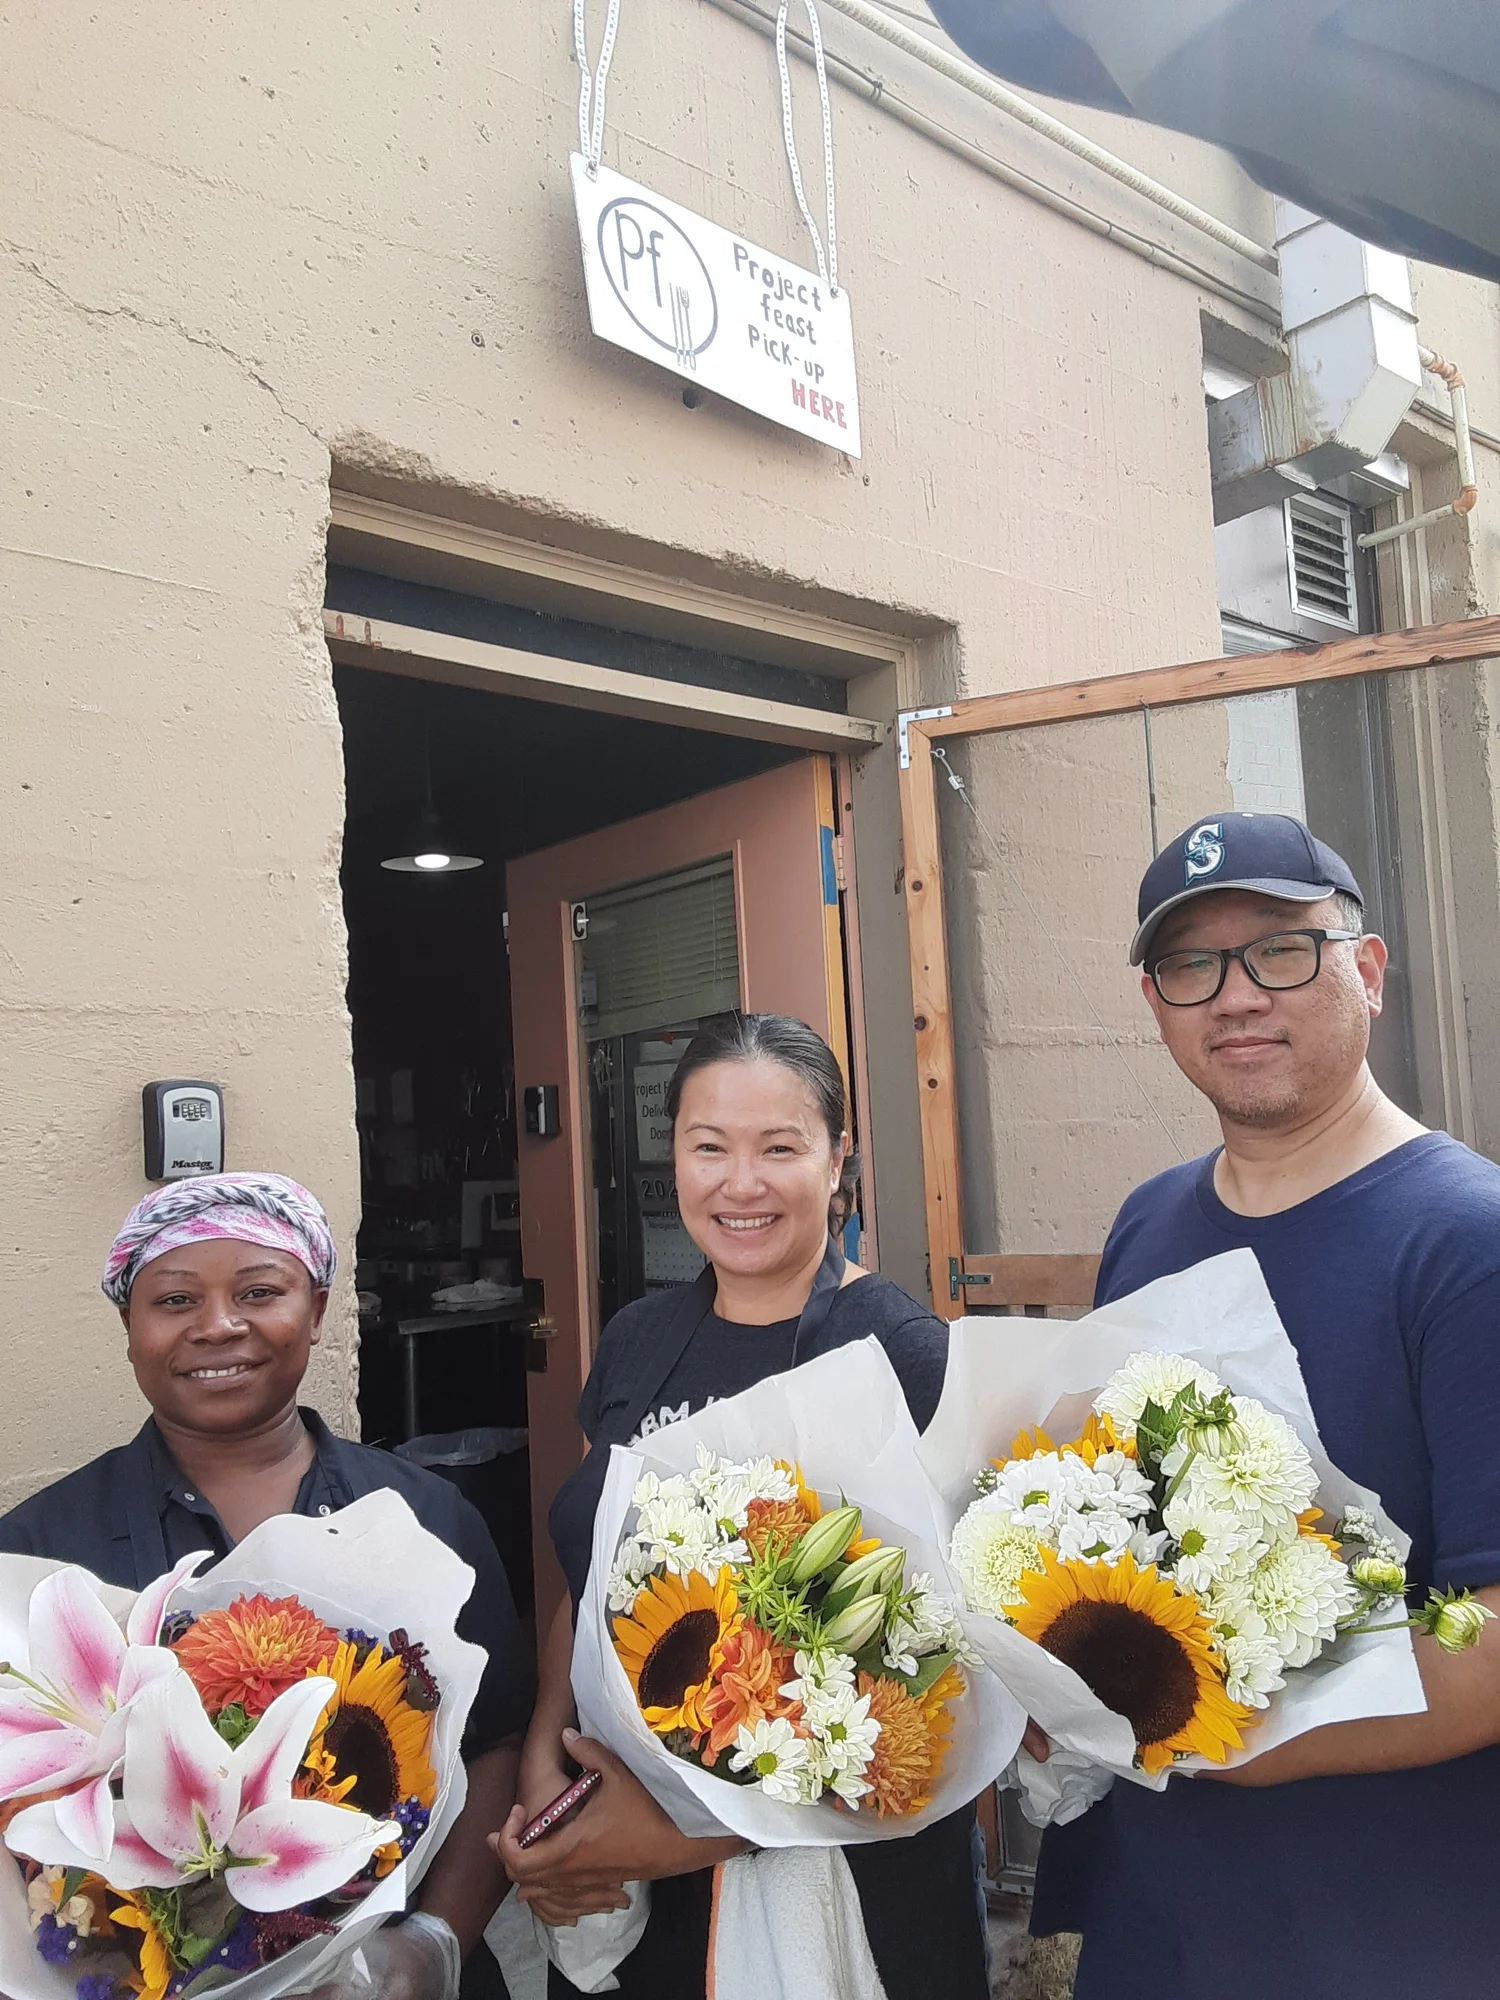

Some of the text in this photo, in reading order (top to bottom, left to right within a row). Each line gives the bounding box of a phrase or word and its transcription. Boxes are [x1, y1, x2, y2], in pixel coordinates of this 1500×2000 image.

[733, 242, 822, 312] Project
[760, 293, 817, 345] feast
[791, 378, 847, 429] HERE
[171, 1160, 212, 1168] Master
